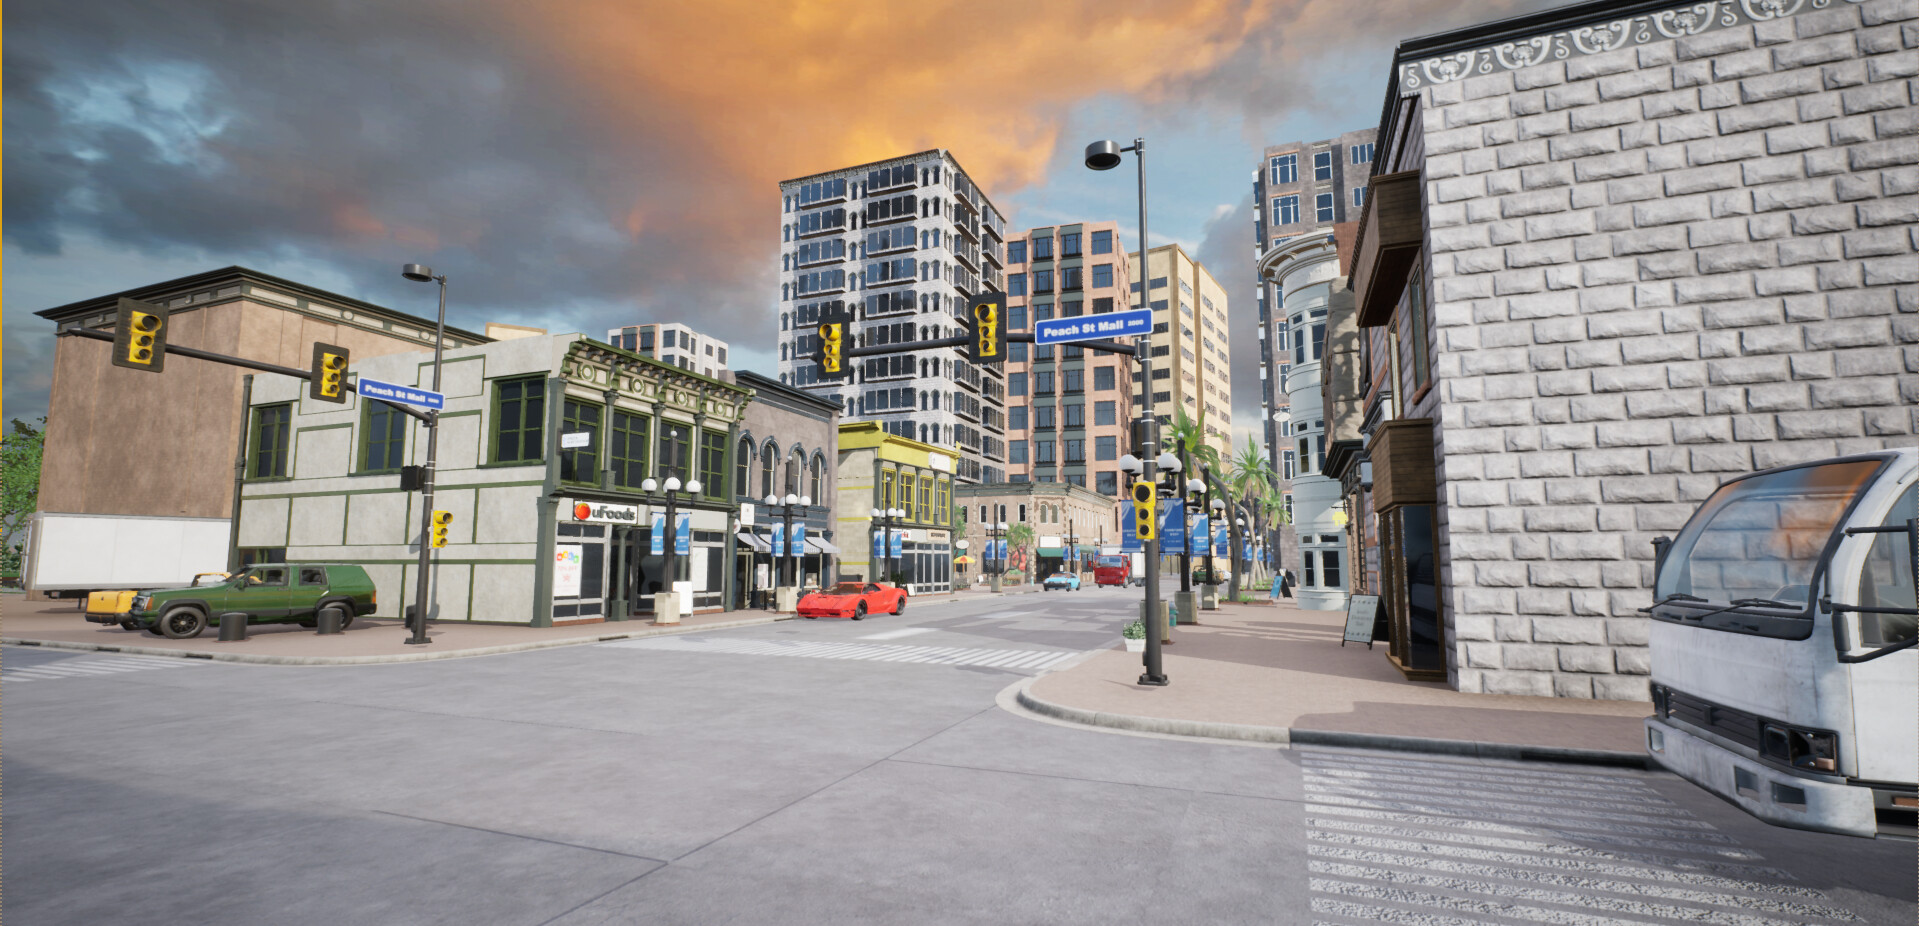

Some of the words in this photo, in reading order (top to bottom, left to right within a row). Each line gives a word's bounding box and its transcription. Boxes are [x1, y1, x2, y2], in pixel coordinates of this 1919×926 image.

[1043, 325, 1079, 337] Peach
[1082, 323, 1095, 333] St
[1098, 320, 1123, 331] Mall
[365, 385, 394, 397] Peach
[395, 390, 406, 399] St
[407, 393, 426, 402] Mall
[592, 505, 635, 521] uFoods
